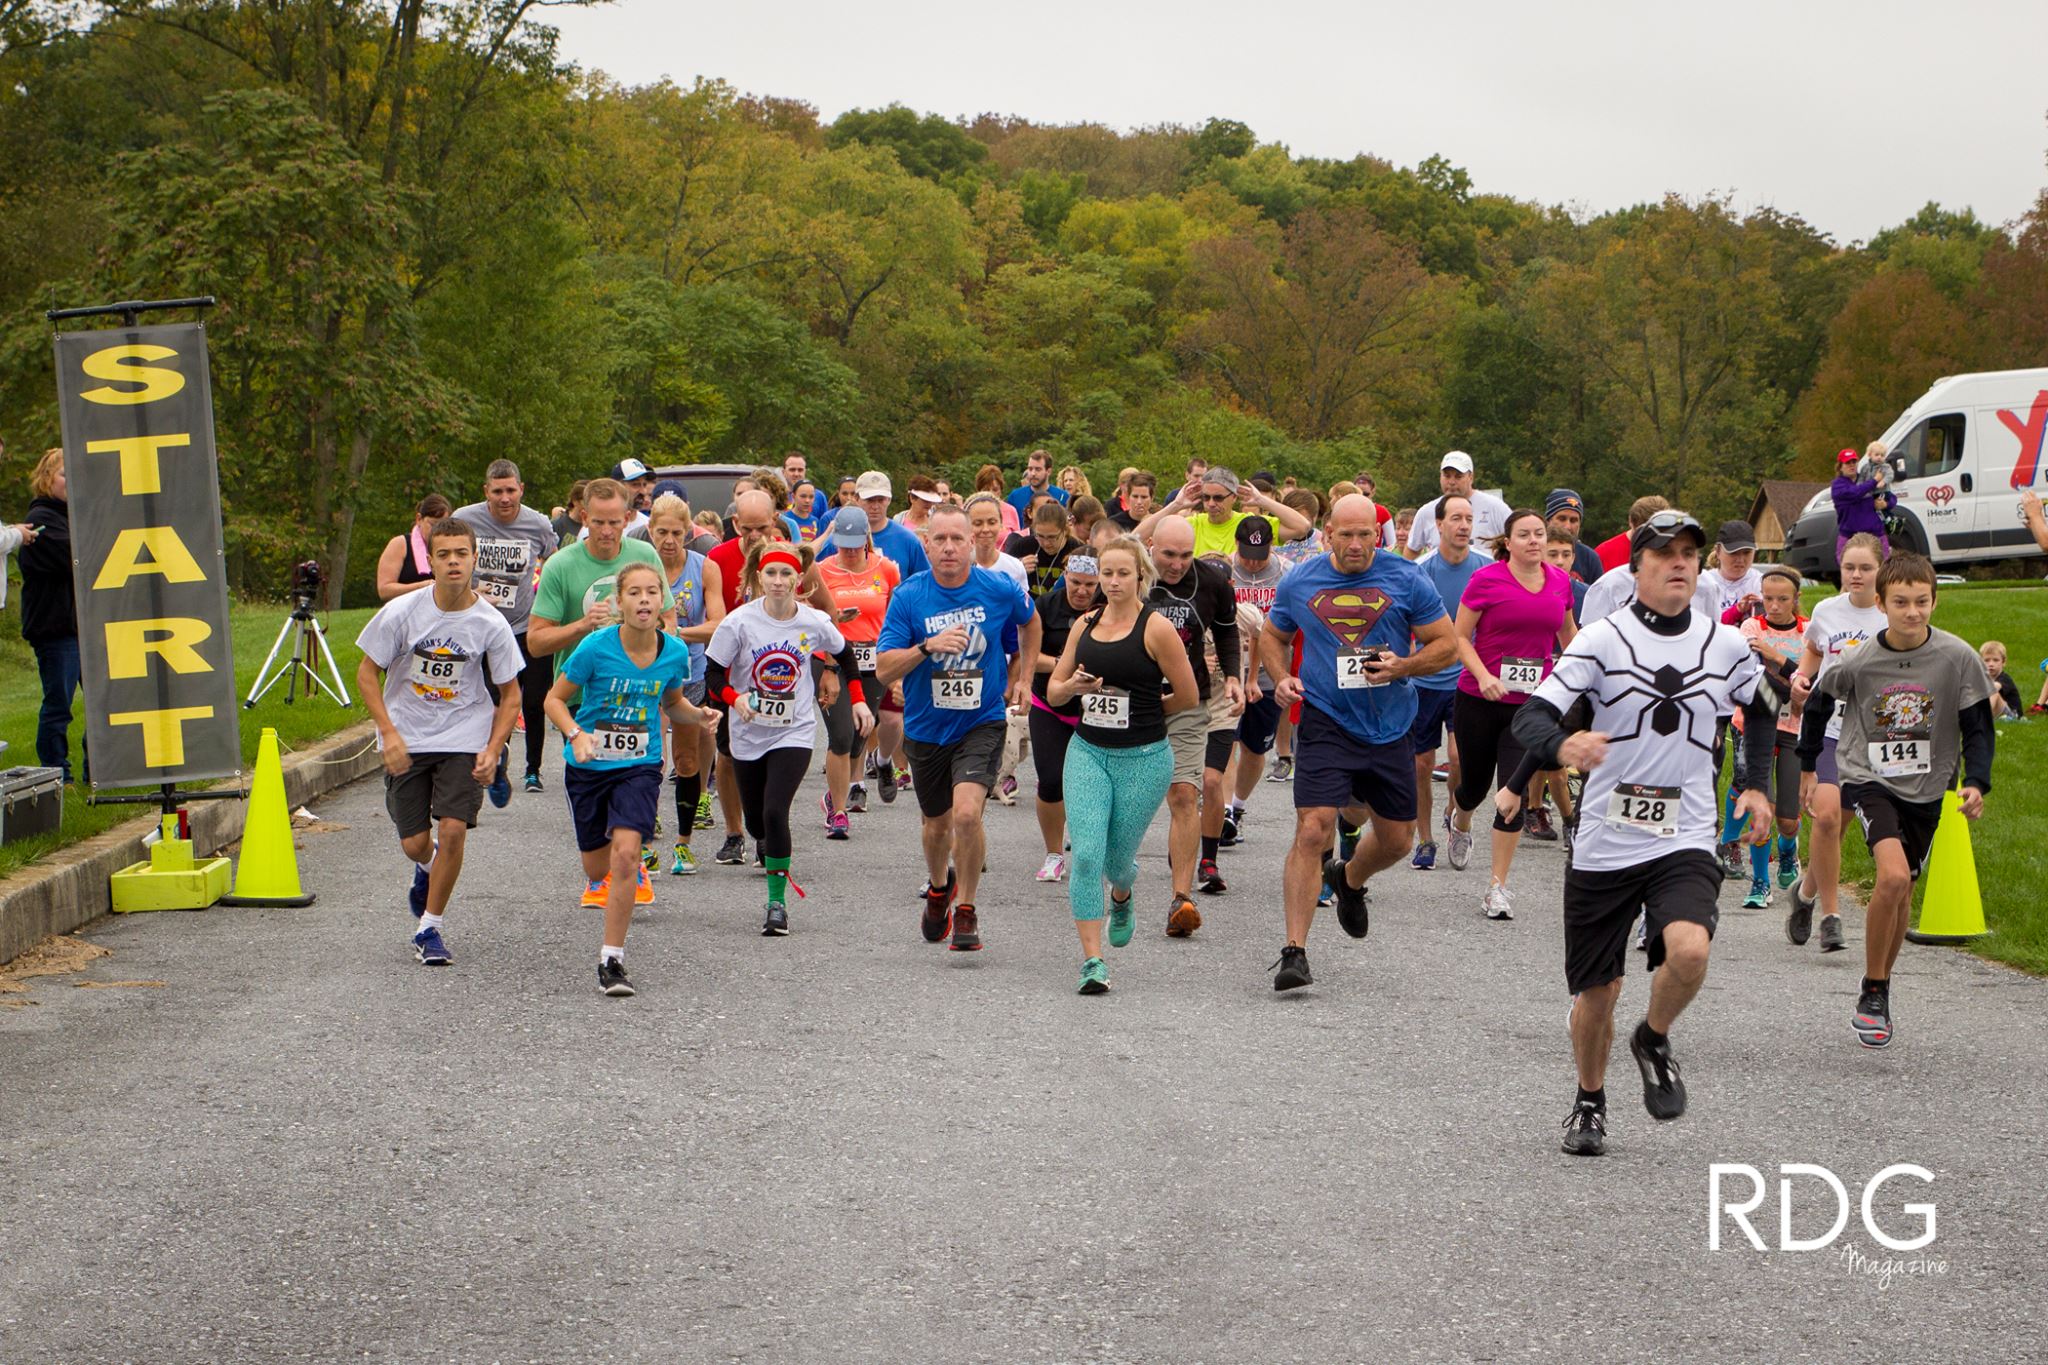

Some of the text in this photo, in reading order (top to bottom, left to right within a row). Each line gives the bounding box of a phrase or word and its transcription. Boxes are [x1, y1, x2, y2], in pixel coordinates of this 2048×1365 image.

[1927, 508, 1957, 517] iHeart
[80, 344, 214, 768] START
[479, 544, 522, 559] WARRIOR
[478, 557, 504, 570] DASH
[485, 583, 510, 598] 236
[924, 606, 986, 634] HEROES
[1168, 606, 1190, 618] FAST
[420, 660, 454, 677] 168
[1508, 666, 1537, 682] 243
[941, 681, 974, 697] 246
[756, 700, 785, 716] 170
[1088, 696, 1119, 715] 245
[603, 733, 638, 750] 169
[1880, 742, 1918, 763] 144
[1621, 797, 1666, 822] 128
